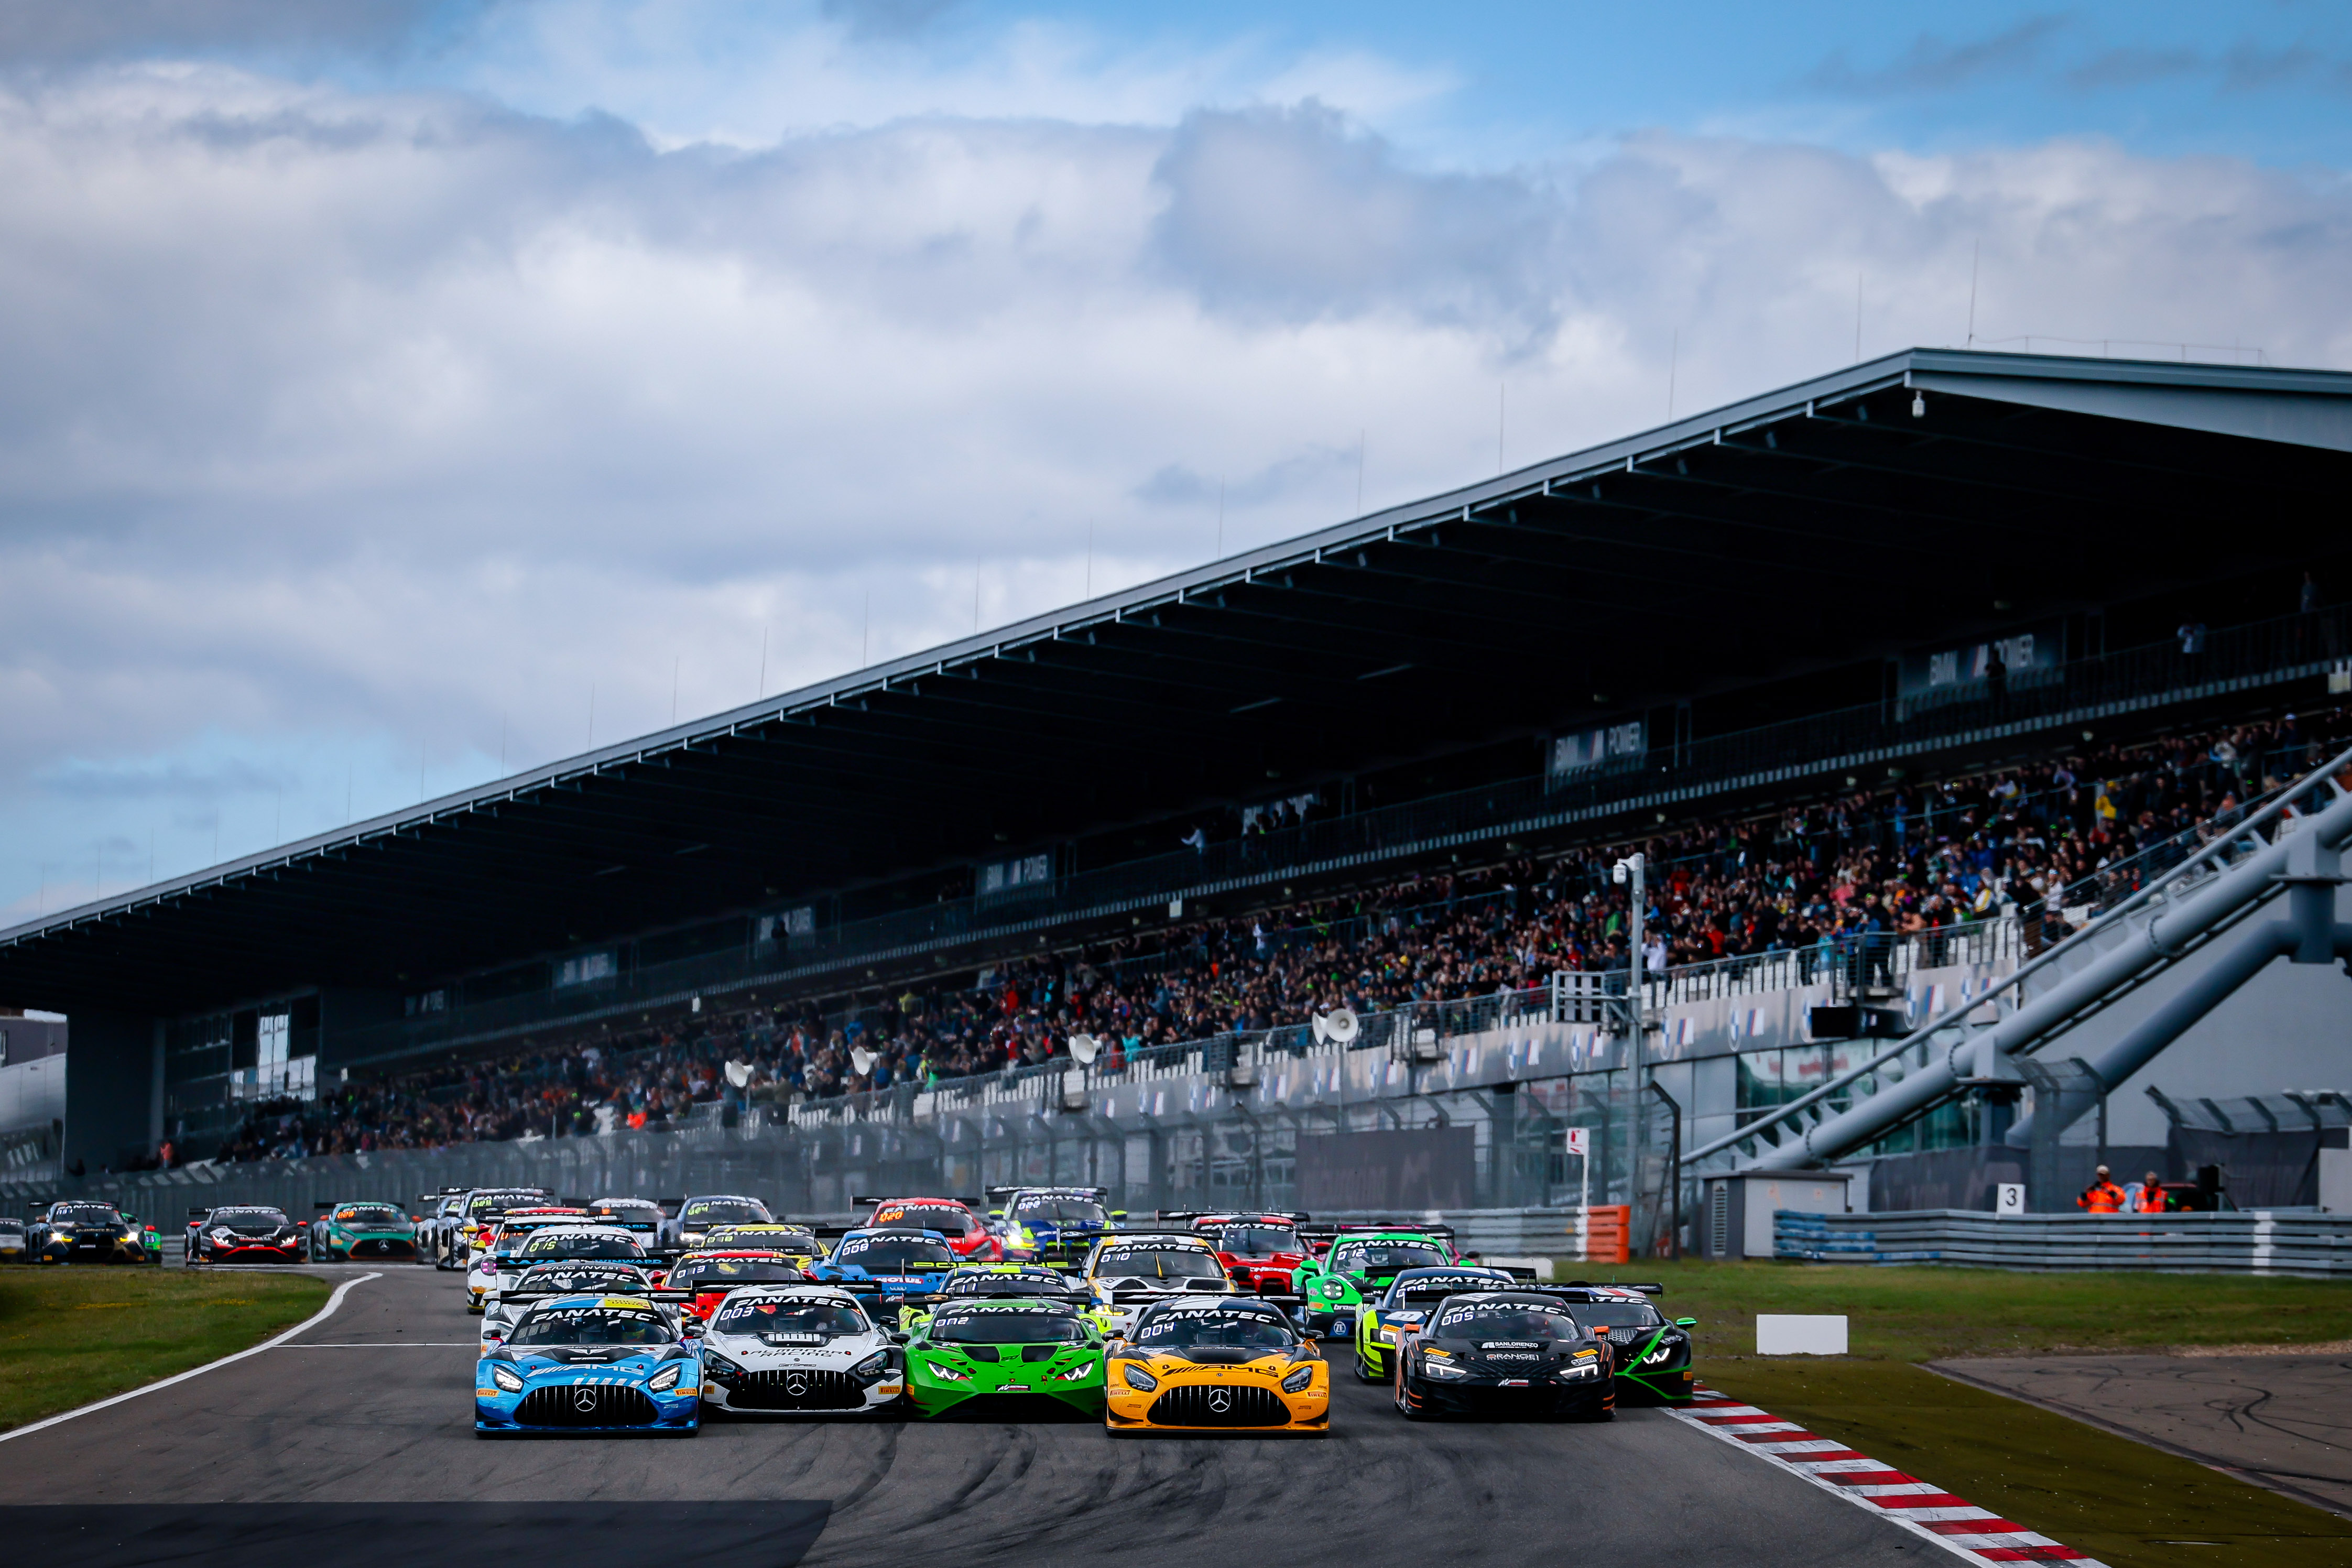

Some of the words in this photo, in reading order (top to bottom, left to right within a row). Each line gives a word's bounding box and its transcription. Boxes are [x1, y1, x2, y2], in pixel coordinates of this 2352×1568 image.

[2005, 1188, 2017, 1206] 3
[1200, 1223, 1291, 1232] FANATEC
[535, 1234, 628, 1243] FANATEC
[844, 1236, 938, 1248] FANATEC
[529, 1241, 557, 1253] 015
[842, 1243, 869, 1256] 008
[1104, 1244, 1205, 1254] FANATEC
[1338, 1240, 1436, 1251] FANATEC
[1101, 1253, 1131, 1263] 010
[1337, 1248, 1366, 1260] 012
[524, 1271, 635, 1284] FANATEC
[677, 1265, 706, 1279] 013
[950, 1275, 1059, 1287] FANATEC
[734, 1297, 846, 1309] FANATEC
[720, 1306, 755, 1321] 003
[1445, 1303, 1563, 1316] FANATEC
[531, 1309, 654, 1324] FANATEC
[1152, 1310, 1273, 1323] FANATEC
[1441, 1312, 1474, 1326] 005
[1140, 1322, 1175, 1339] 004
[1432, 1355, 1452, 1364] Castrol
[1577, 1356, 1596, 1364] Castrol
